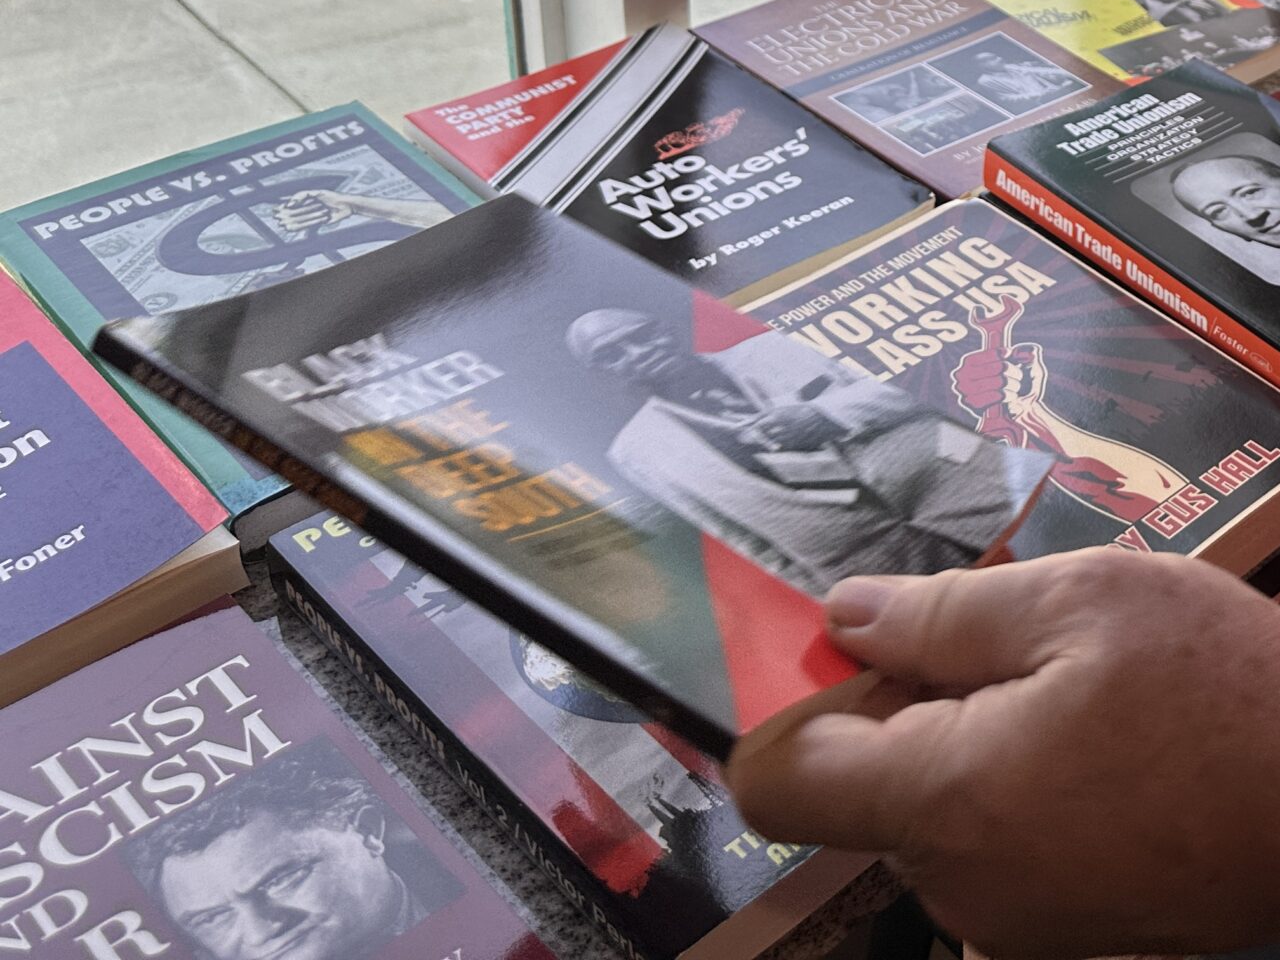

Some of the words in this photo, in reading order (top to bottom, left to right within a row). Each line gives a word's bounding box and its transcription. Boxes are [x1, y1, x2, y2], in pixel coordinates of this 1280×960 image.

[763, 18, 885, 65] UNIONS
[778, 52, 840, 76] THE
[838, 24, 912, 57] COLD
[907, 0, 970, 29] WAR
[434, 104, 469, 117] The
[445, 74, 577, 124] COMMUNIST
[455, 105, 525, 134] PARTY
[1056, 128, 1120, 156] Trade
[1112, 92, 1203, 135] Unionism
[1063, 93, 1160, 137] American
[466, 125, 503, 141] and
[504, 114, 536, 129] the
[1106, 115, 1205, 162] ORGANIZATION
[1107, 115, 1185, 151] PRINCIPLES
[1130, 128, 1199, 162] STRATEGY
[1146, 137, 1203, 164] TACTICS
[33, 185, 170, 240] PEOPLE
[169, 170, 227, 192] VS.
[230, 120, 366, 176] PROFITS
[599, 155, 706, 204] Auto
[640, 170, 803, 239] Unions
[689, 252, 718, 270] by
[719, 225, 782, 256] Roger
[781, 196, 855, 230] Keeran
[778, 295, 836, 327] POWER
[834, 277, 866, 301] AND
[859, 264, 894, 285] THE
[886, 225, 964, 271] MOVEMENT
[995, 168, 1074, 238] American
[1074, 222, 1123, 272] Trade
[1125, 258, 1208, 333] Unionism
[1212, 324, 1249, 356] Foster
[838, 310, 969, 383] LASS
[952, 261, 1057, 318] USA
[1141, 483, 1219, 540] GUS
[0, 524, 86, 582] Foner
[374, 672, 445, 759] PROFITS
